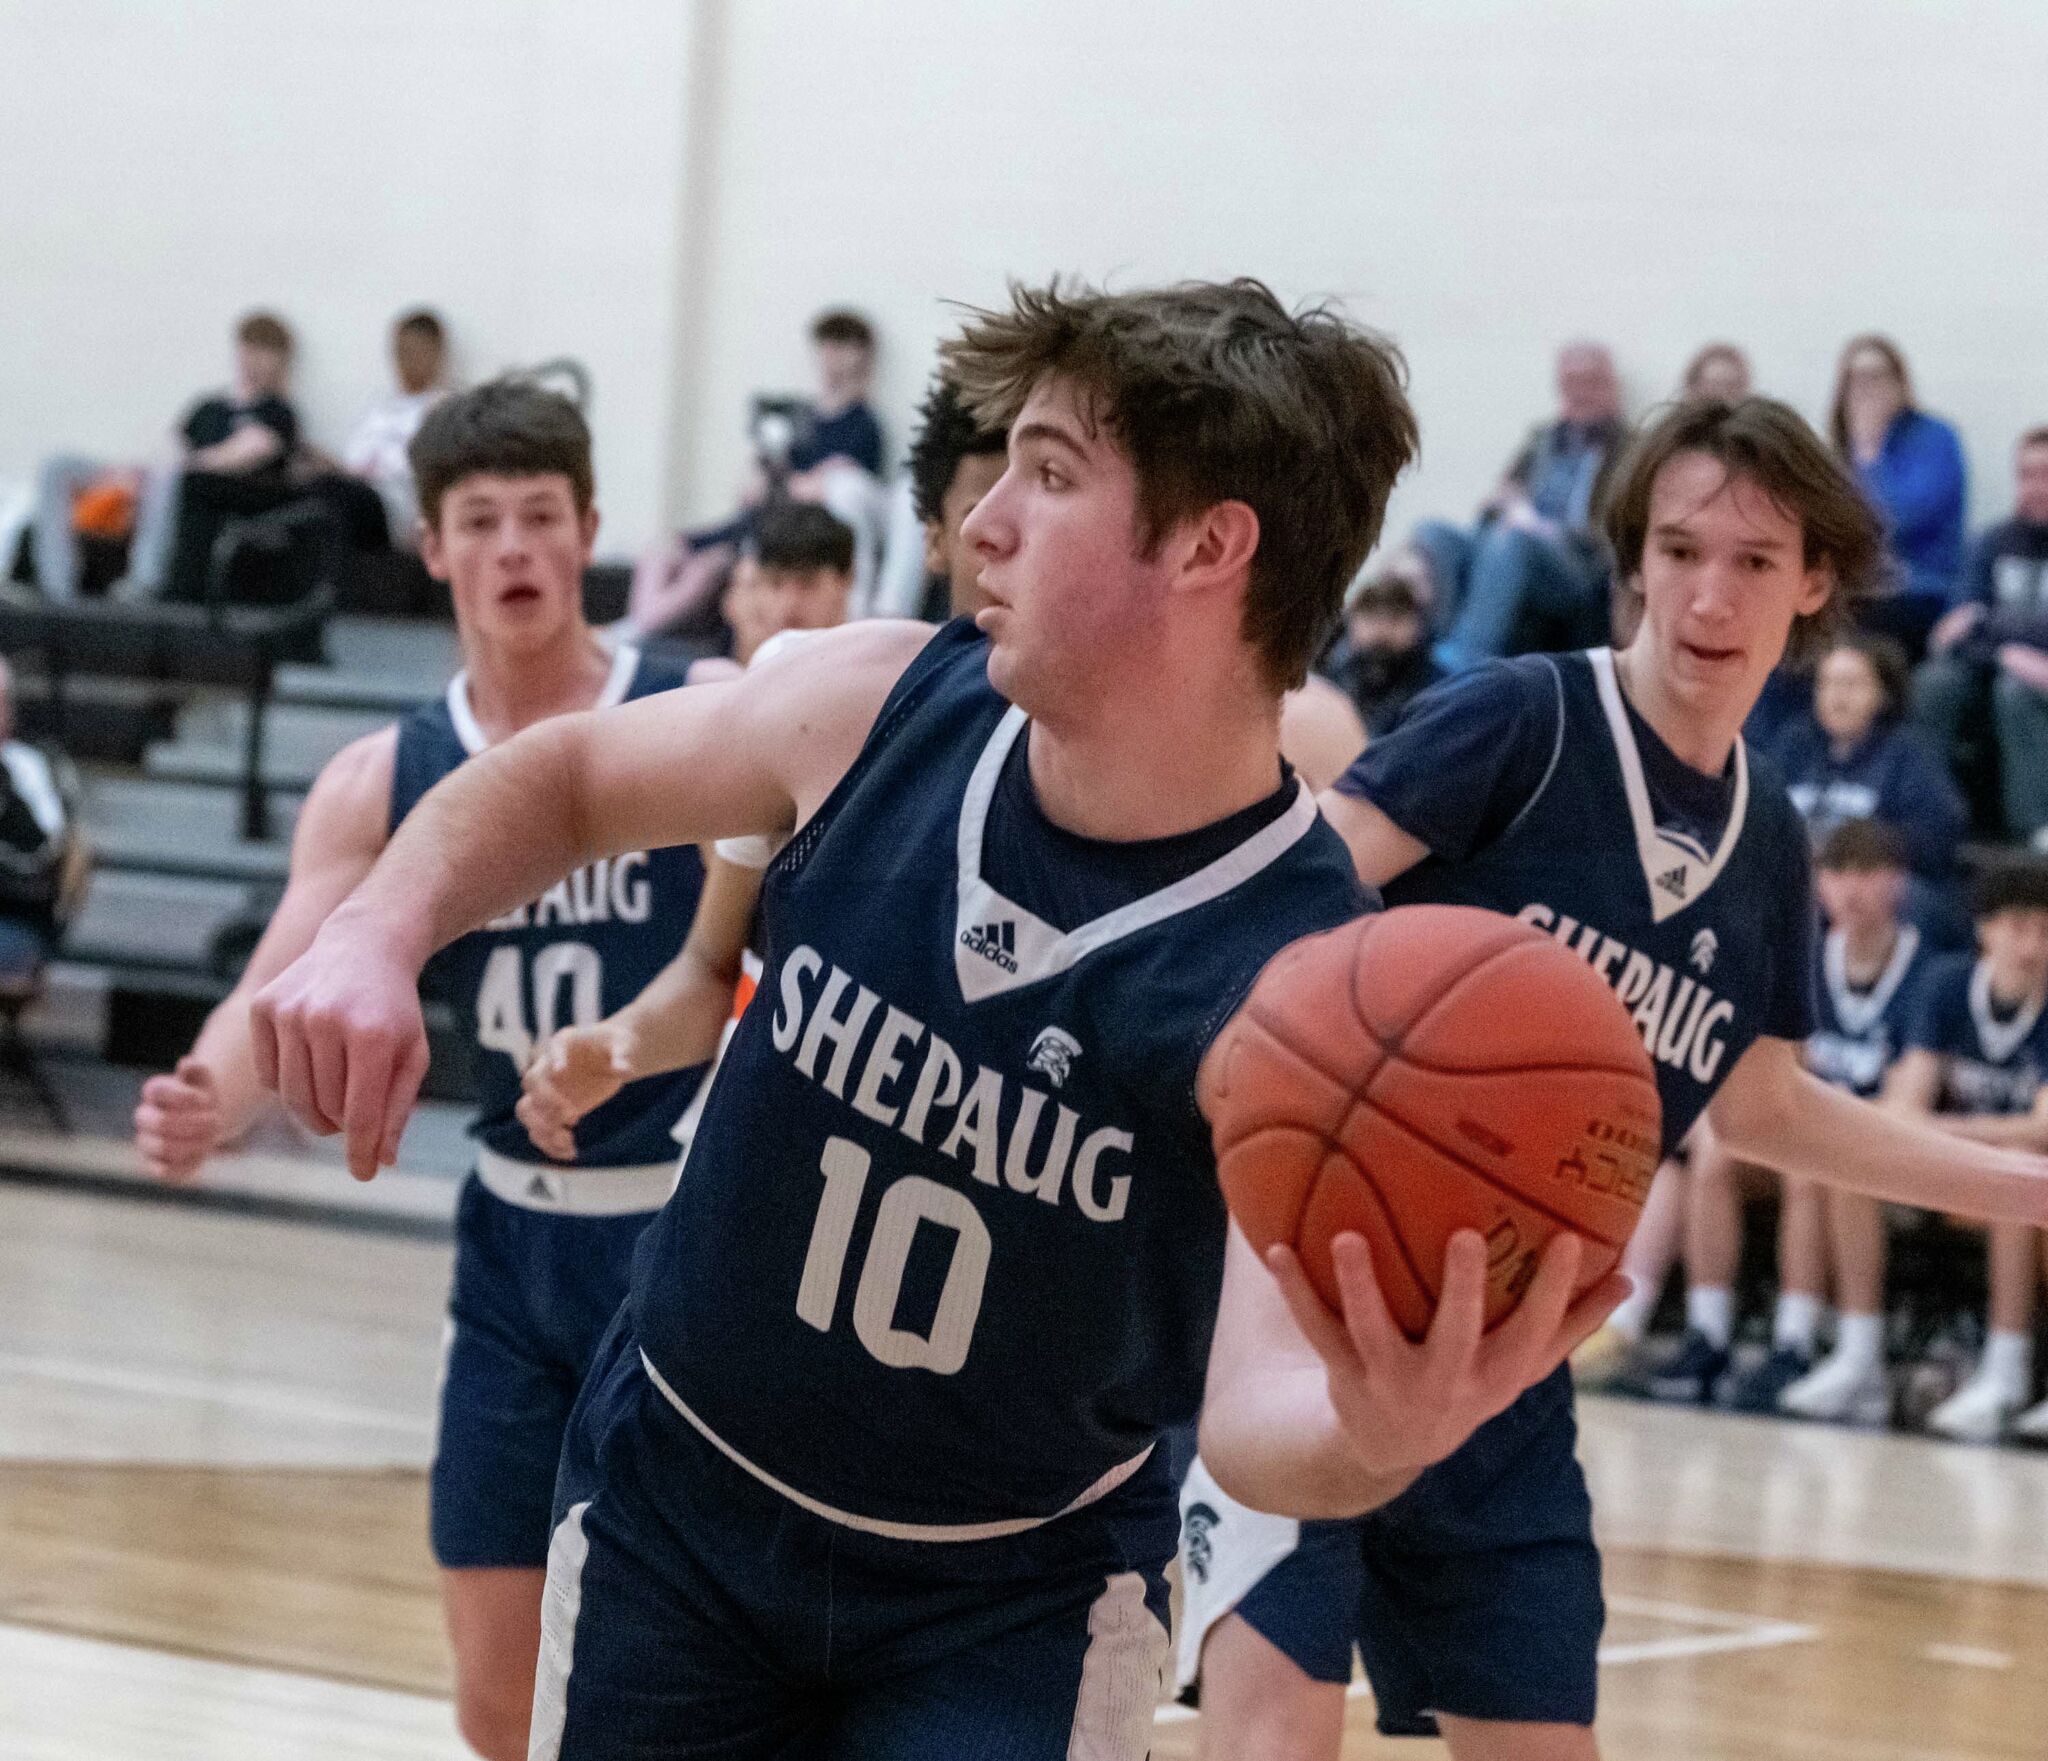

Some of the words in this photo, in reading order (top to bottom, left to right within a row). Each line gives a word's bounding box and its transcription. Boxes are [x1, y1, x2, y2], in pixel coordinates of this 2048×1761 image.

[961, 930, 1019, 975] adidas
[771, 944, 1135, 1223] SHEPAUG
[795, 1135, 993, 1376] 10
